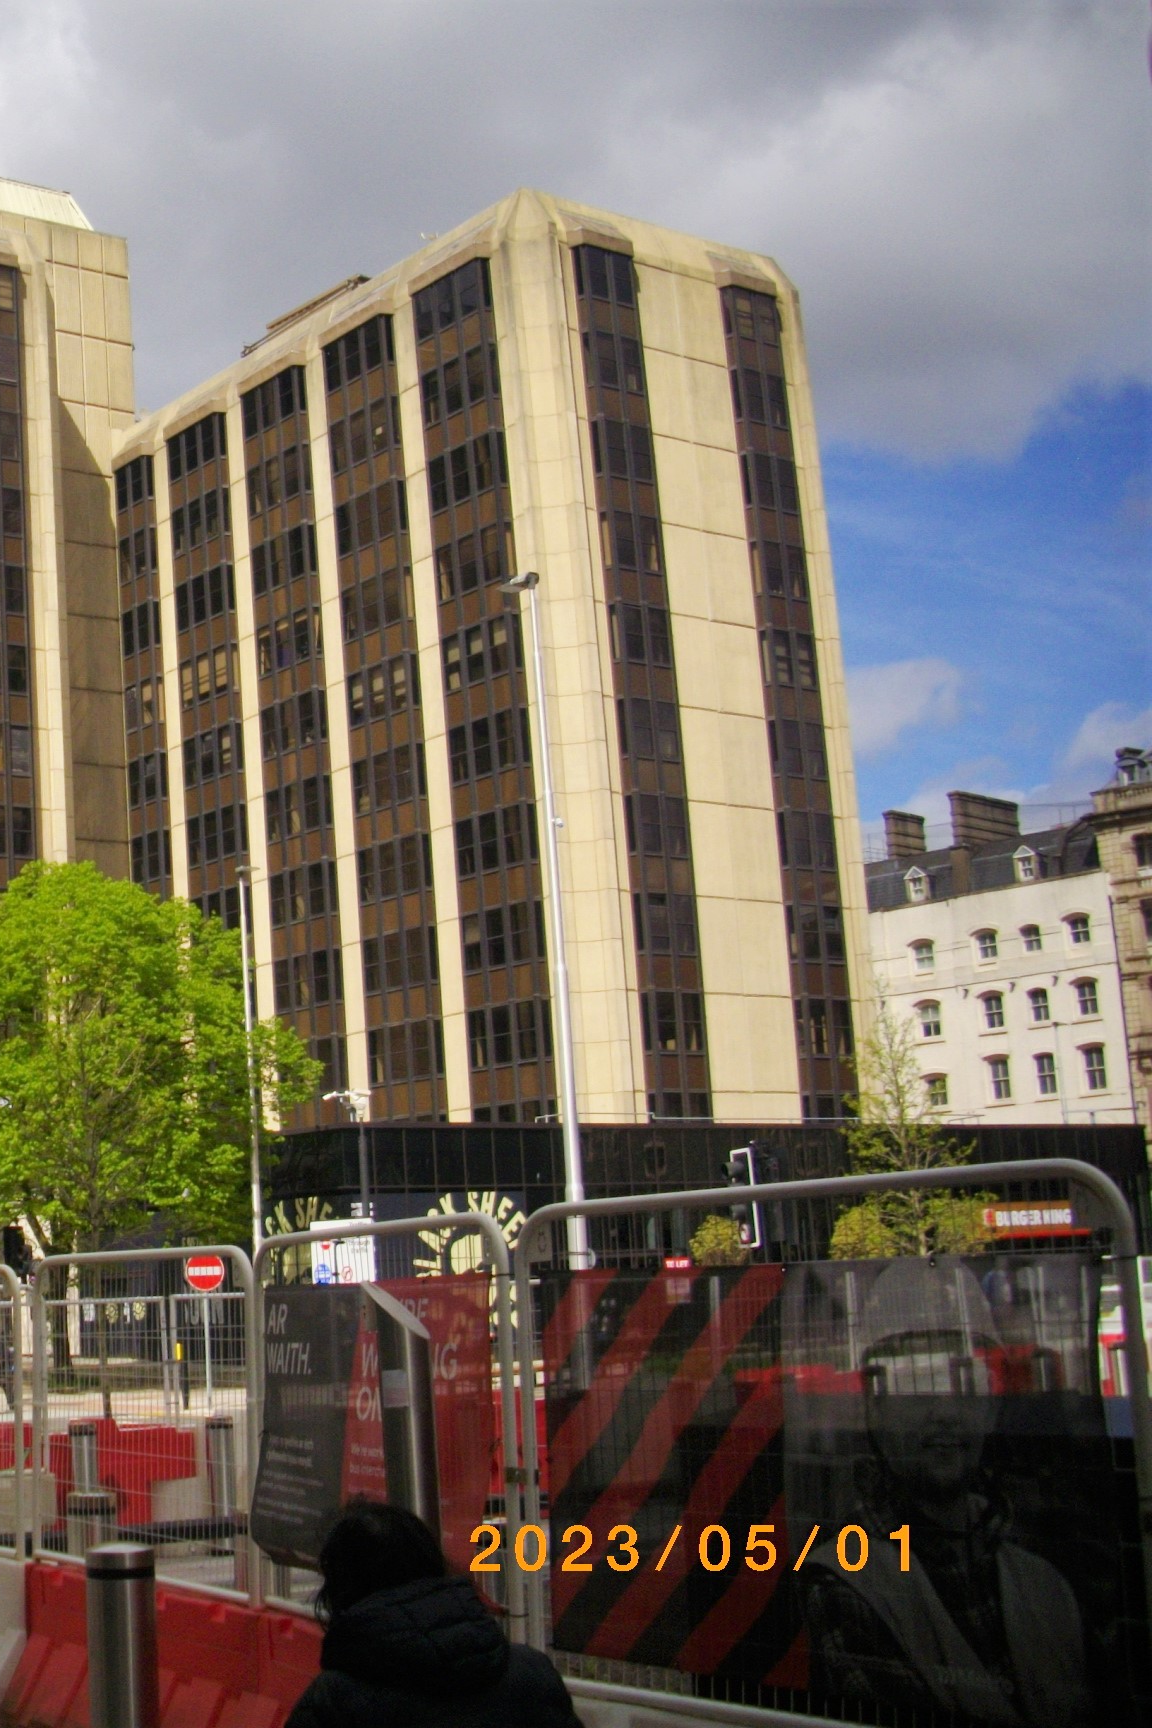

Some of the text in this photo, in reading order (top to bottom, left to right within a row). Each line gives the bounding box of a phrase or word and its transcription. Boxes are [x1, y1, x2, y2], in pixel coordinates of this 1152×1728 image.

[467, 1191, 528, 1250] SHEE
[995, 1208, 1071, 1226] BURGER KING
[267, 1304, 288, 1334] AR
[267, 1343, 312, 1375] WAITH.
